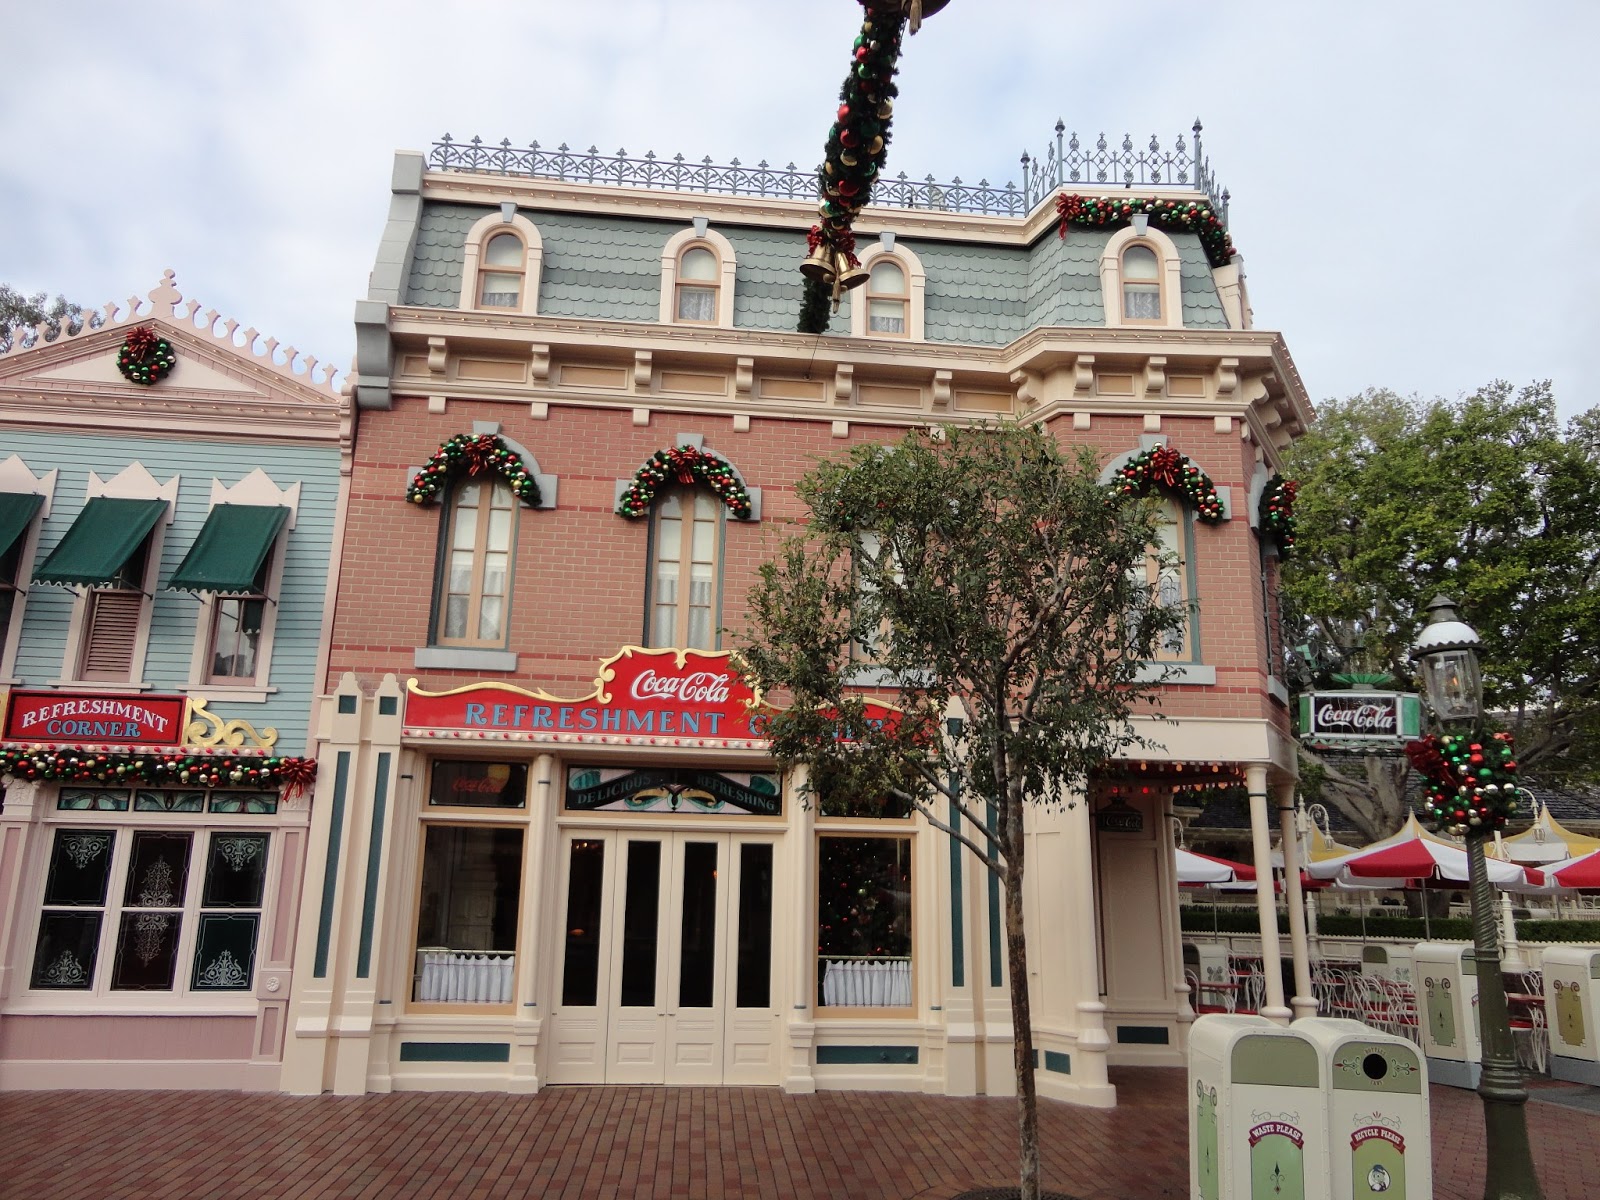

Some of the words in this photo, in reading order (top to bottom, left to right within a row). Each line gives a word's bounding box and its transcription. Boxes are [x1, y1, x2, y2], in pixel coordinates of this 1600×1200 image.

[631, 669, 730, 702] Coca-Cola
[21, 699, 168, 733] REFRESHMENT
[46, 719, 141, 738] CORNER
[465, 702, 725, 735] REFRESHMENT
[1317, 703, 1394, 729] Coca-Cola
[576, 773, 651, 805] DELICIOUS
[696, 774, 775, 811] REFRESHING
[1252, 1124, 1275, 1138] WASTE
[1276, 1124, 1301, 1141] PLEASE
[1354, 1128, 1379, 1142] RECYCLE
[1380, 1129, 1402, 1145] PLEASE
